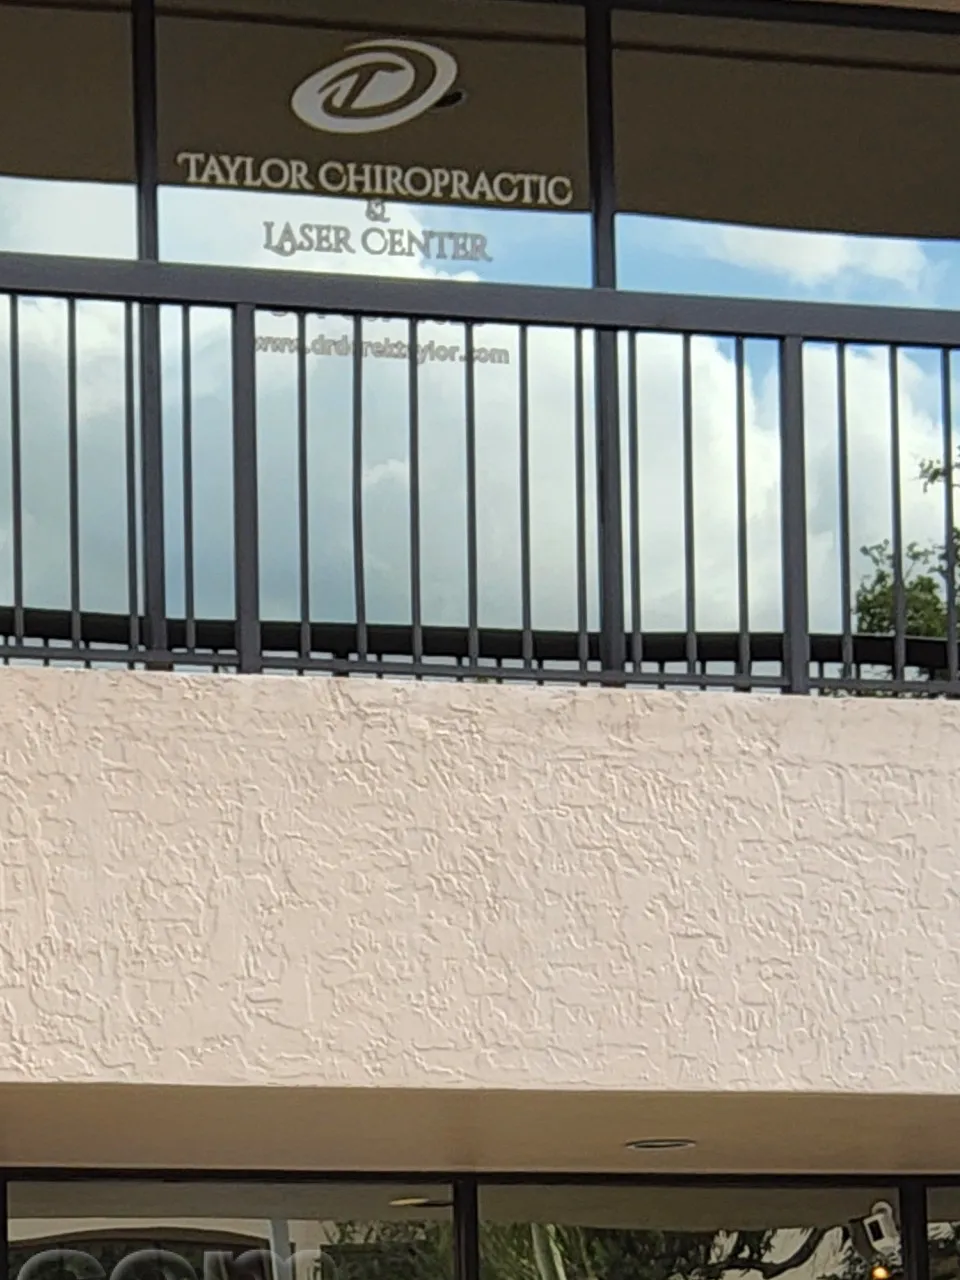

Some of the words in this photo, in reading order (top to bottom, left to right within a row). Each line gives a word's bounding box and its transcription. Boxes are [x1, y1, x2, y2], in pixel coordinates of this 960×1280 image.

[176, 152, 315, 192] TAYLOR
[319, 160, 574, 207] CHIROPRACTIC
[364, 200, 391, 223] &
[262, 221, 357, 257] LASER
[360, 227, 494, 262] CENTER
[252, 334, 510, 366] www.drdrektylor.com
